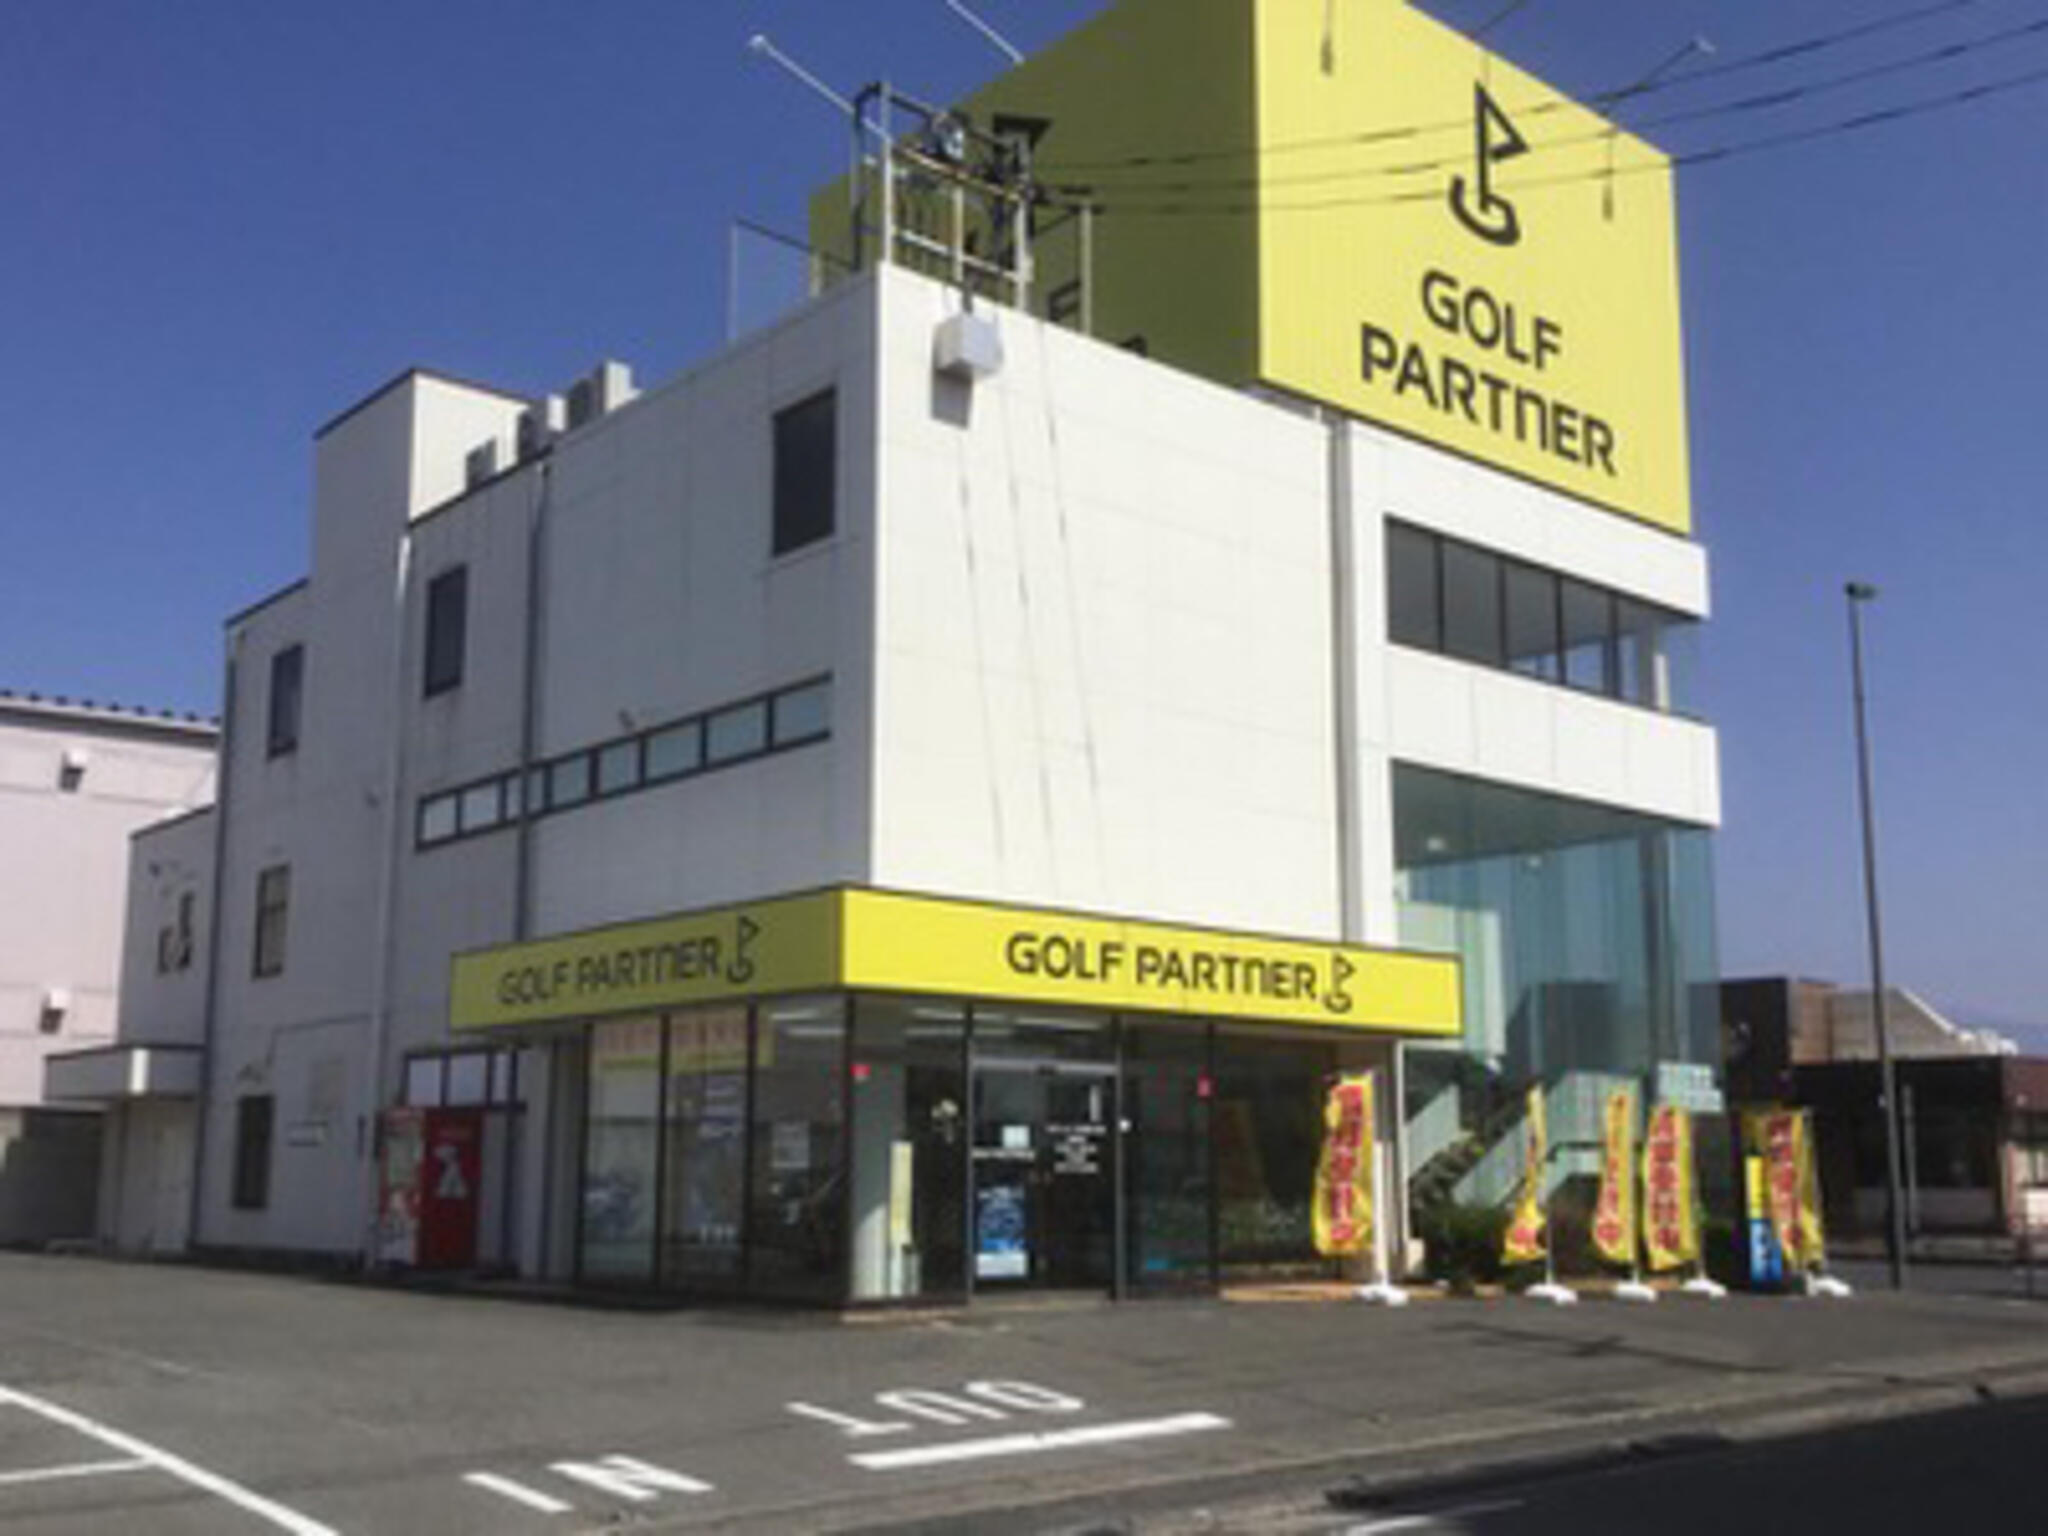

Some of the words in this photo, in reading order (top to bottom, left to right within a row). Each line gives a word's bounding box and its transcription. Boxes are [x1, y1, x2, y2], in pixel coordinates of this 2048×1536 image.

[1421, 269, 1562, 370] GOLF
[1360, 322, 1616, 476] PARTNER
[499, 961, 570, 1005] GOLF
[576, 936, 721, 994] PARTNER
[1006, 932, 1125, 982] GOLF
[1136, 946, 1317, 1001] PARTNER
[461, 1455, 715, 1512] IN
